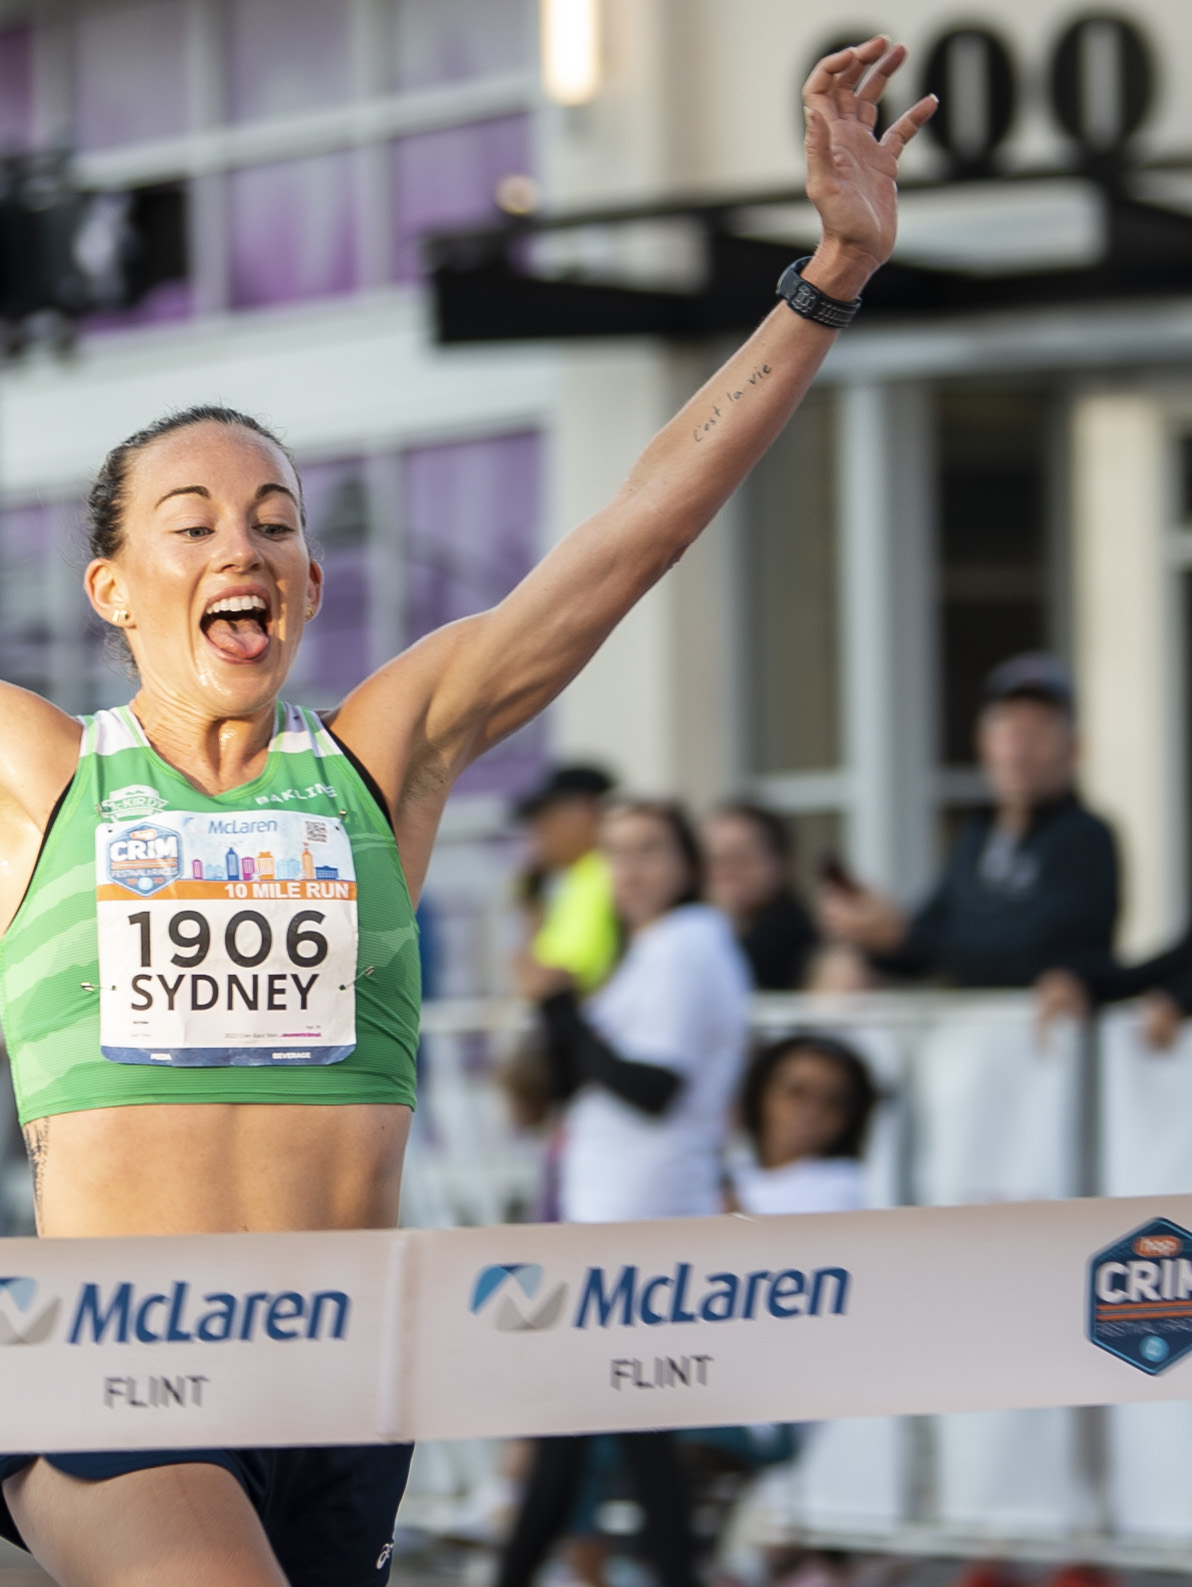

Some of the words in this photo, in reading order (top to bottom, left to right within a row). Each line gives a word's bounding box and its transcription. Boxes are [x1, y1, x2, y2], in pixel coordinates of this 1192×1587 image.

[796, 18, 1153, 172] 00
[726, 391, 743, 402] la
[749, 365, 772, 385] vie
[209, 820, 278, 834] McLaren
[109, 836, 177, 861] CRIM
[225, 883, 248, 898] 10
[253, 882, 301, 898] MILE
[306, 882, 349, 898] RUN
[128, 910, 328, 968] 1906
[131, 974, 319, 1011] SYDNEY
[65, 1281, 353, 1344] McLaren
[571, 1262, 852, 1329] McLaren
[610, 1354, 715, 1391] FLINT
[103, 1375, 210, 1409] FLINT
